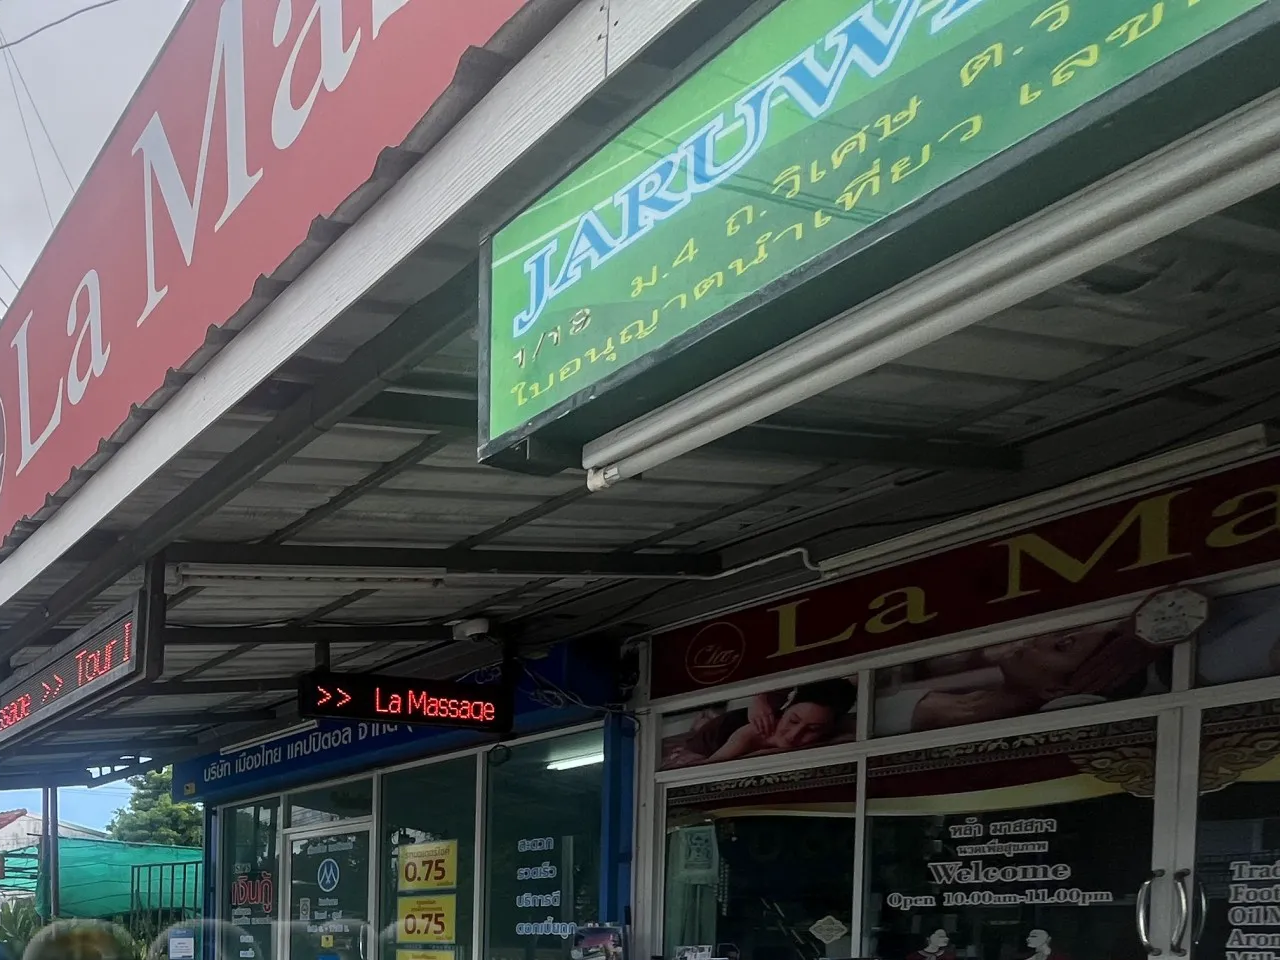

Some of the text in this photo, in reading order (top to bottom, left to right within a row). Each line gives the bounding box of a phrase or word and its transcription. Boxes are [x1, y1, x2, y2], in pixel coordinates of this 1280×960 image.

[9, 0, 412, 477] La Ma
[765, 583, 940, 660] La
[75, 639, 118, 687] Tour
[375, 686, 402, 714] La
[203, 758, 232, 784] บริษัท
[235, 743, 282, 775] เมืองไทย
[517, 836, 555, 853] สะดวก
[404, 858, 446, 883] 0.75
[516, 860, 558, 881] รวดเร็ว
[927, 861, 1072, 885] Welcome
[515, 889, 561, 908] บริการดี
[886, 892, 937, 911] Open
[404, 912, 445, 936] 0.75
